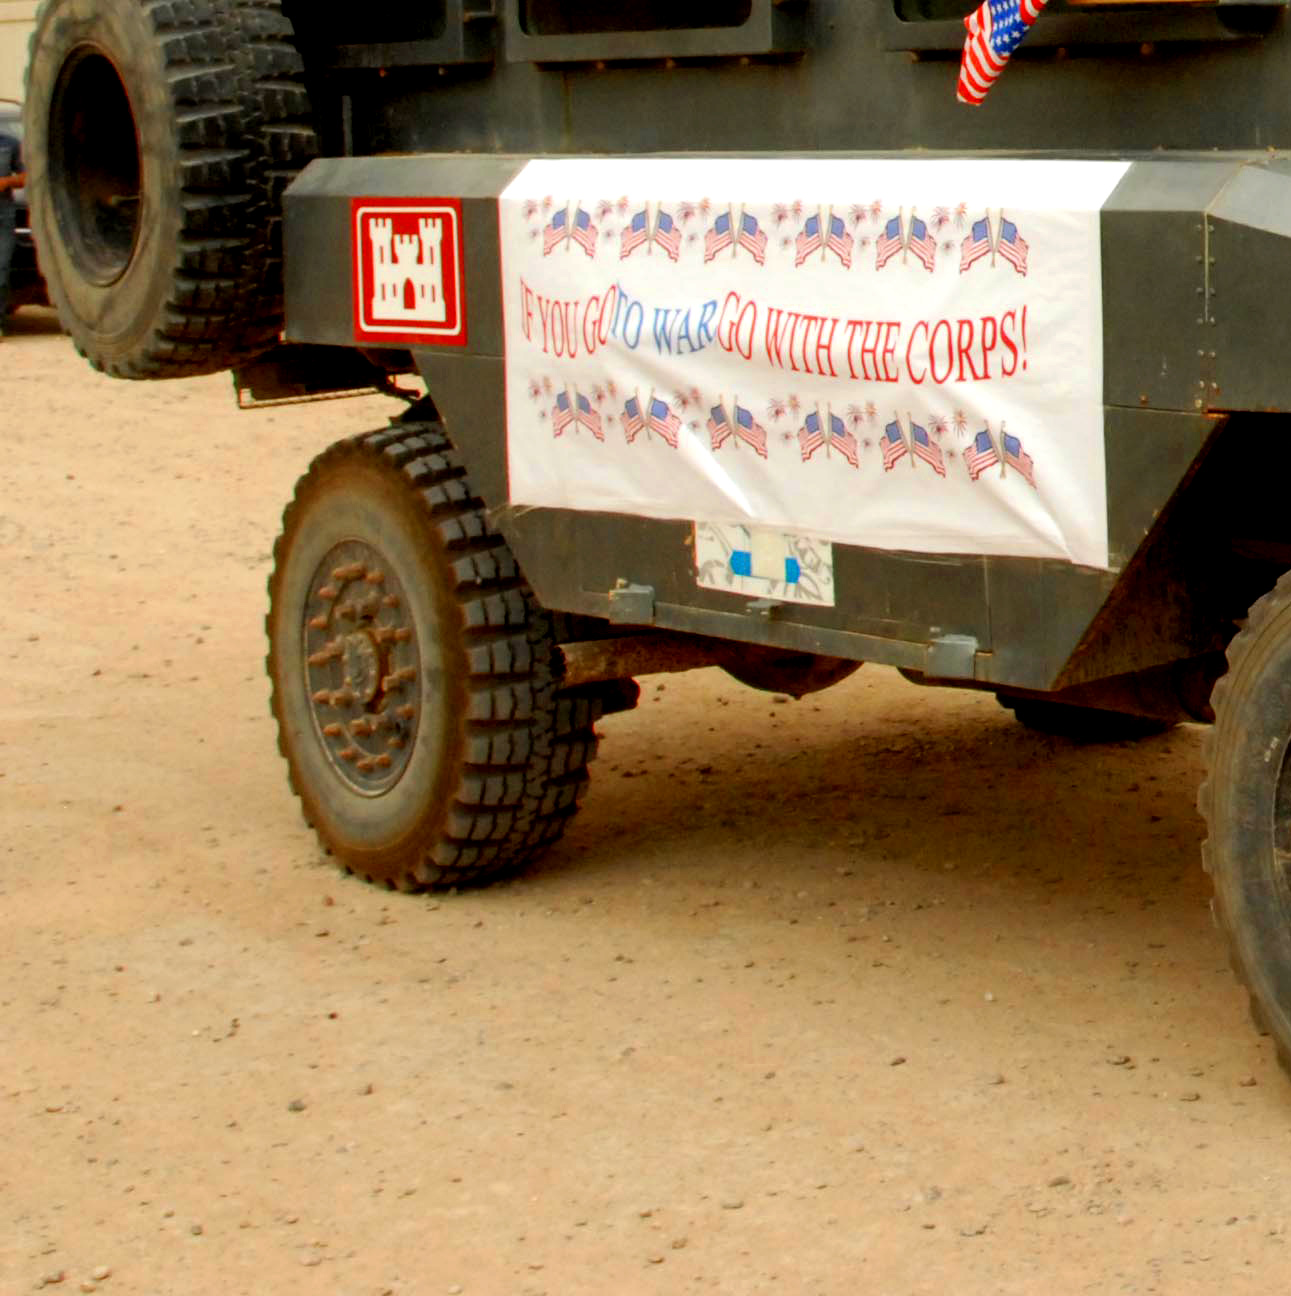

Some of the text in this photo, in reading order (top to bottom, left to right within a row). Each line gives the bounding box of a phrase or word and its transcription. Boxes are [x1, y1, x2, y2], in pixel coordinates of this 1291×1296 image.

[520, 278, 1028, 385] IF YOU GO TO WAR GO WITH THE CORPS!
